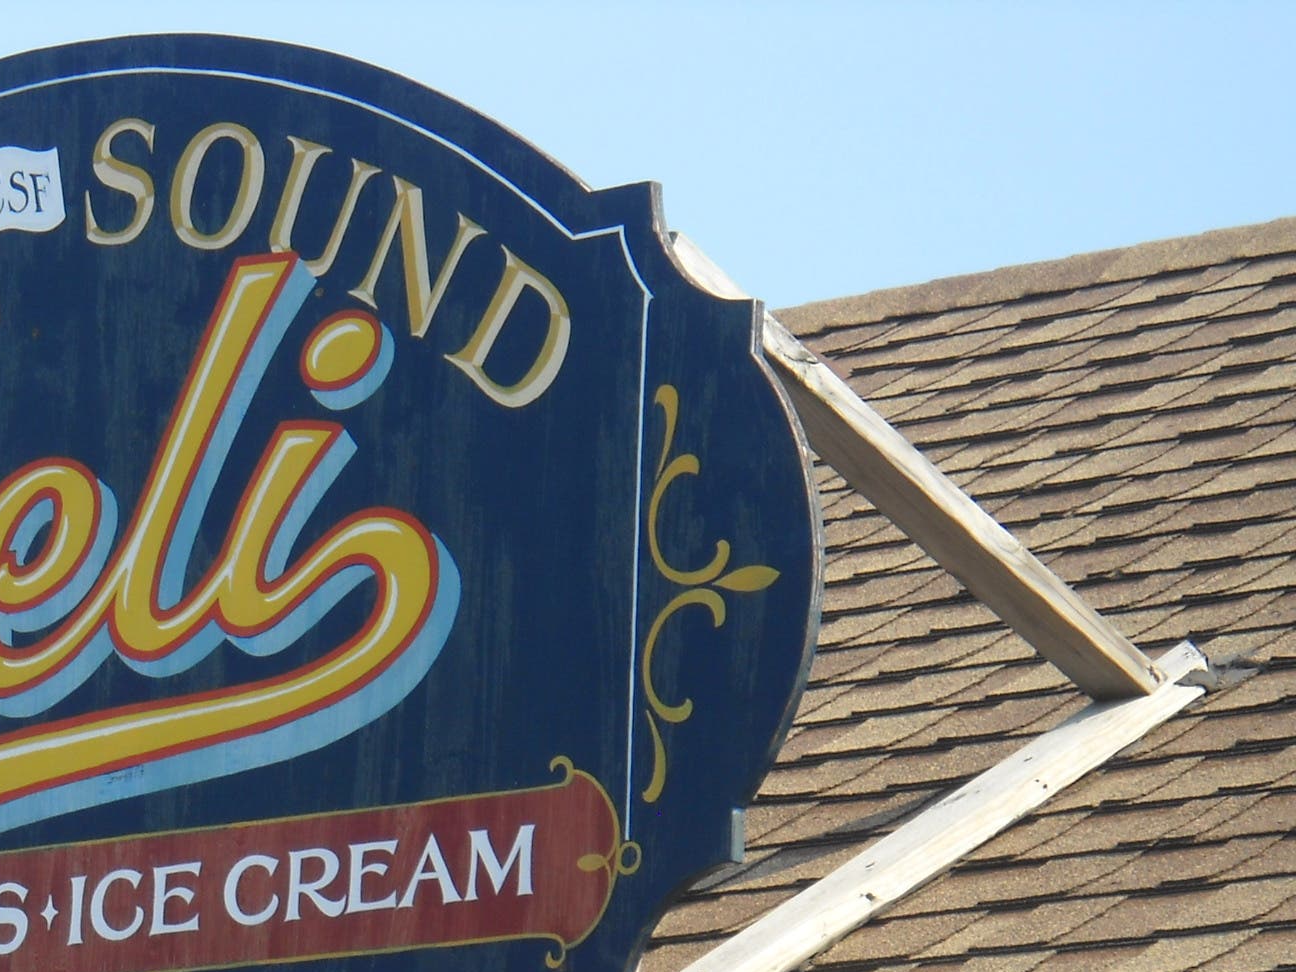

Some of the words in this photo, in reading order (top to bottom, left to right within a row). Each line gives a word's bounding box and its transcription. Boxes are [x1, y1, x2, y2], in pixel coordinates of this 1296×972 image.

[85, 117, 572, 408] SOUND
[66, 861, 202, 947] ICE
[223, 824, 536, 927] CREAM
